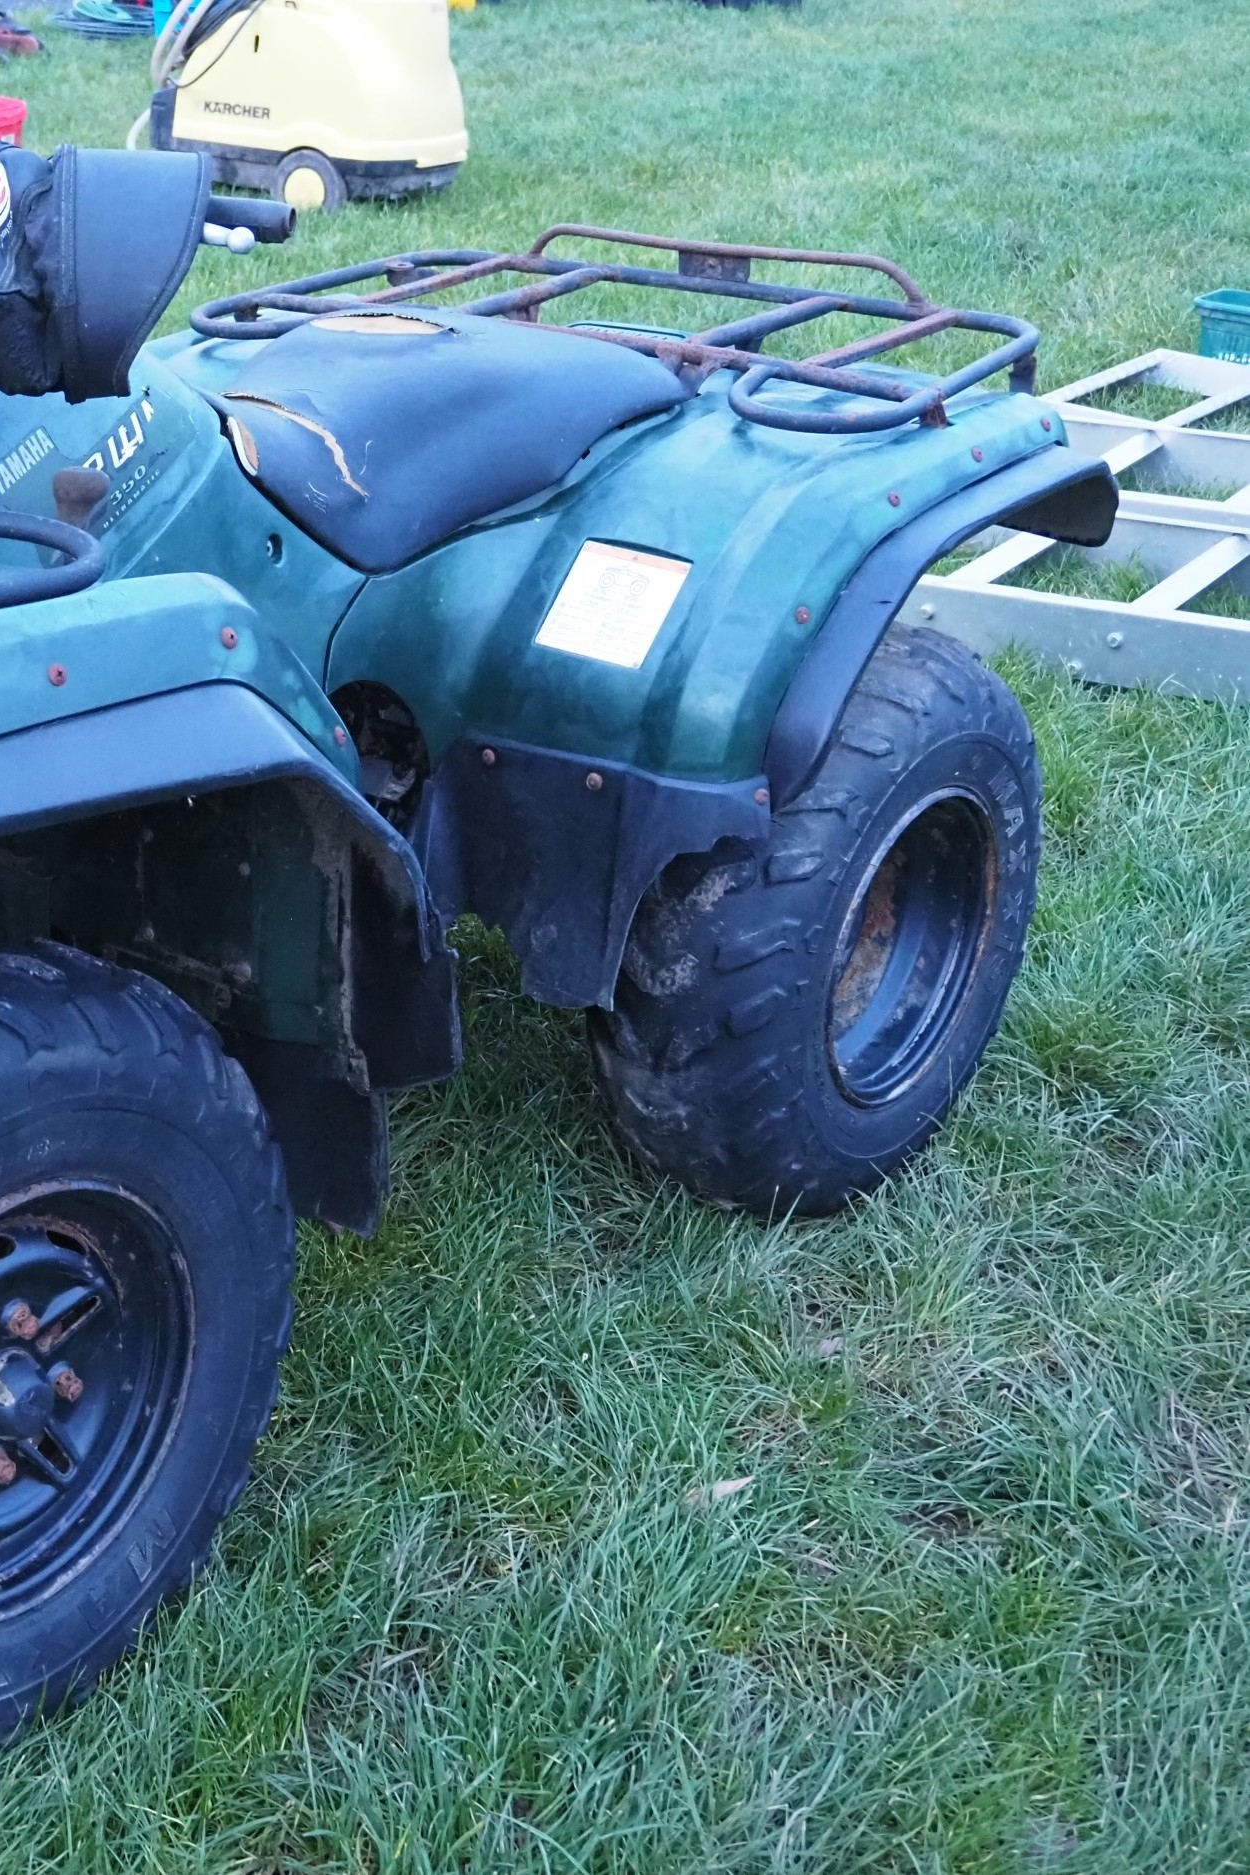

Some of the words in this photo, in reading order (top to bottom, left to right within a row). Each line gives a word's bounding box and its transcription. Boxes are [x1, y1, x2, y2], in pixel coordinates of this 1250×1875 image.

[102, 469, 160, 529] ULTRAMATIC
[110, 464, 146, 506] 350
[984, 763, 1026, 993] MAXXIS
